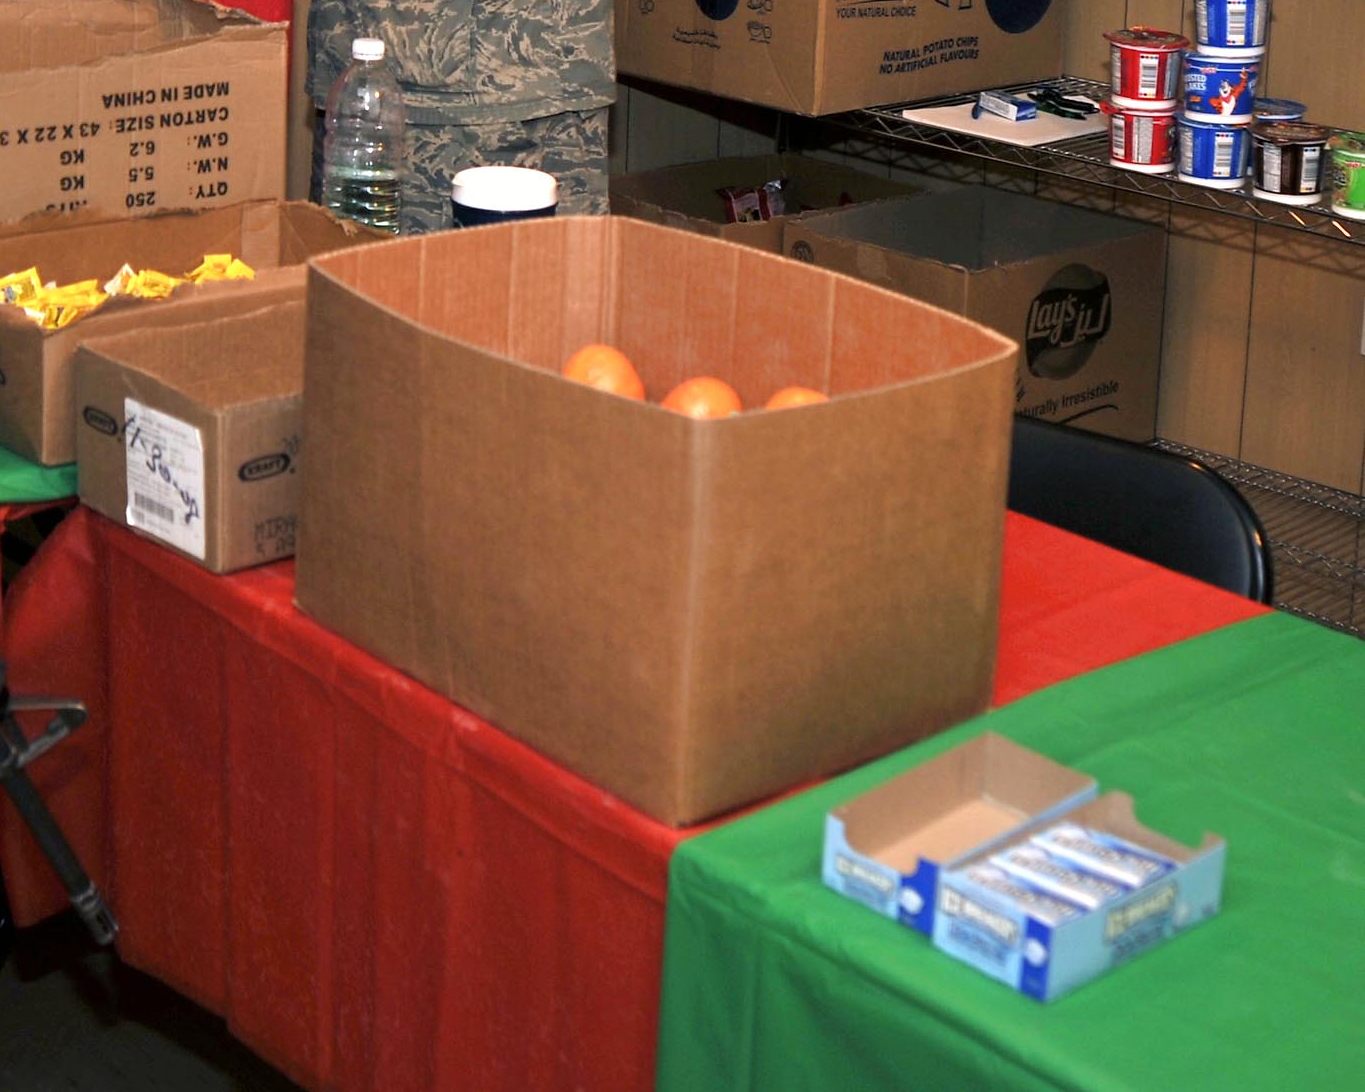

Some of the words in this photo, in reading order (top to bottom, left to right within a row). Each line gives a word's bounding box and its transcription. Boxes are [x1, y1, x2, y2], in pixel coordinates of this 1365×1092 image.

[837, 8, 856, 19] YOUR
[858, 7, 889, 17] NATURAL
[891, 6, 916, 16] CHOICE
[884, 49, 920, 62] NATURAL
[923, 39, 954, 55] POTATO
[957, 37, 979, 47] CHIPS
[879, 64, 893, 74] NO
[895, 55, 937, 73] ARTIFICIAL
[940, 49, 979, 64] FLAVOURS
[161, 88, 177, 102] IN
[184, 82, 228, 100] MADE
[102, 90, 155, 108] CHINA
[160, 107, 228, 127] CARTON
[18, 130, 27, 144] X
[35, 126, 56, 142] 22
[63, 125, 73, 138] X
[80, 123, 100, 137] 43
[130, 141, 155, 156] 6.2
[60, 150, 84, 165] KG
[129, 167, 153, 182] 5.5
[61, 176, 83, 191] KG
[126, 192, 155, 207] 250
[1027, 293, 1077, 344] Lay's
[1019, 398, 1058, 417] turally
